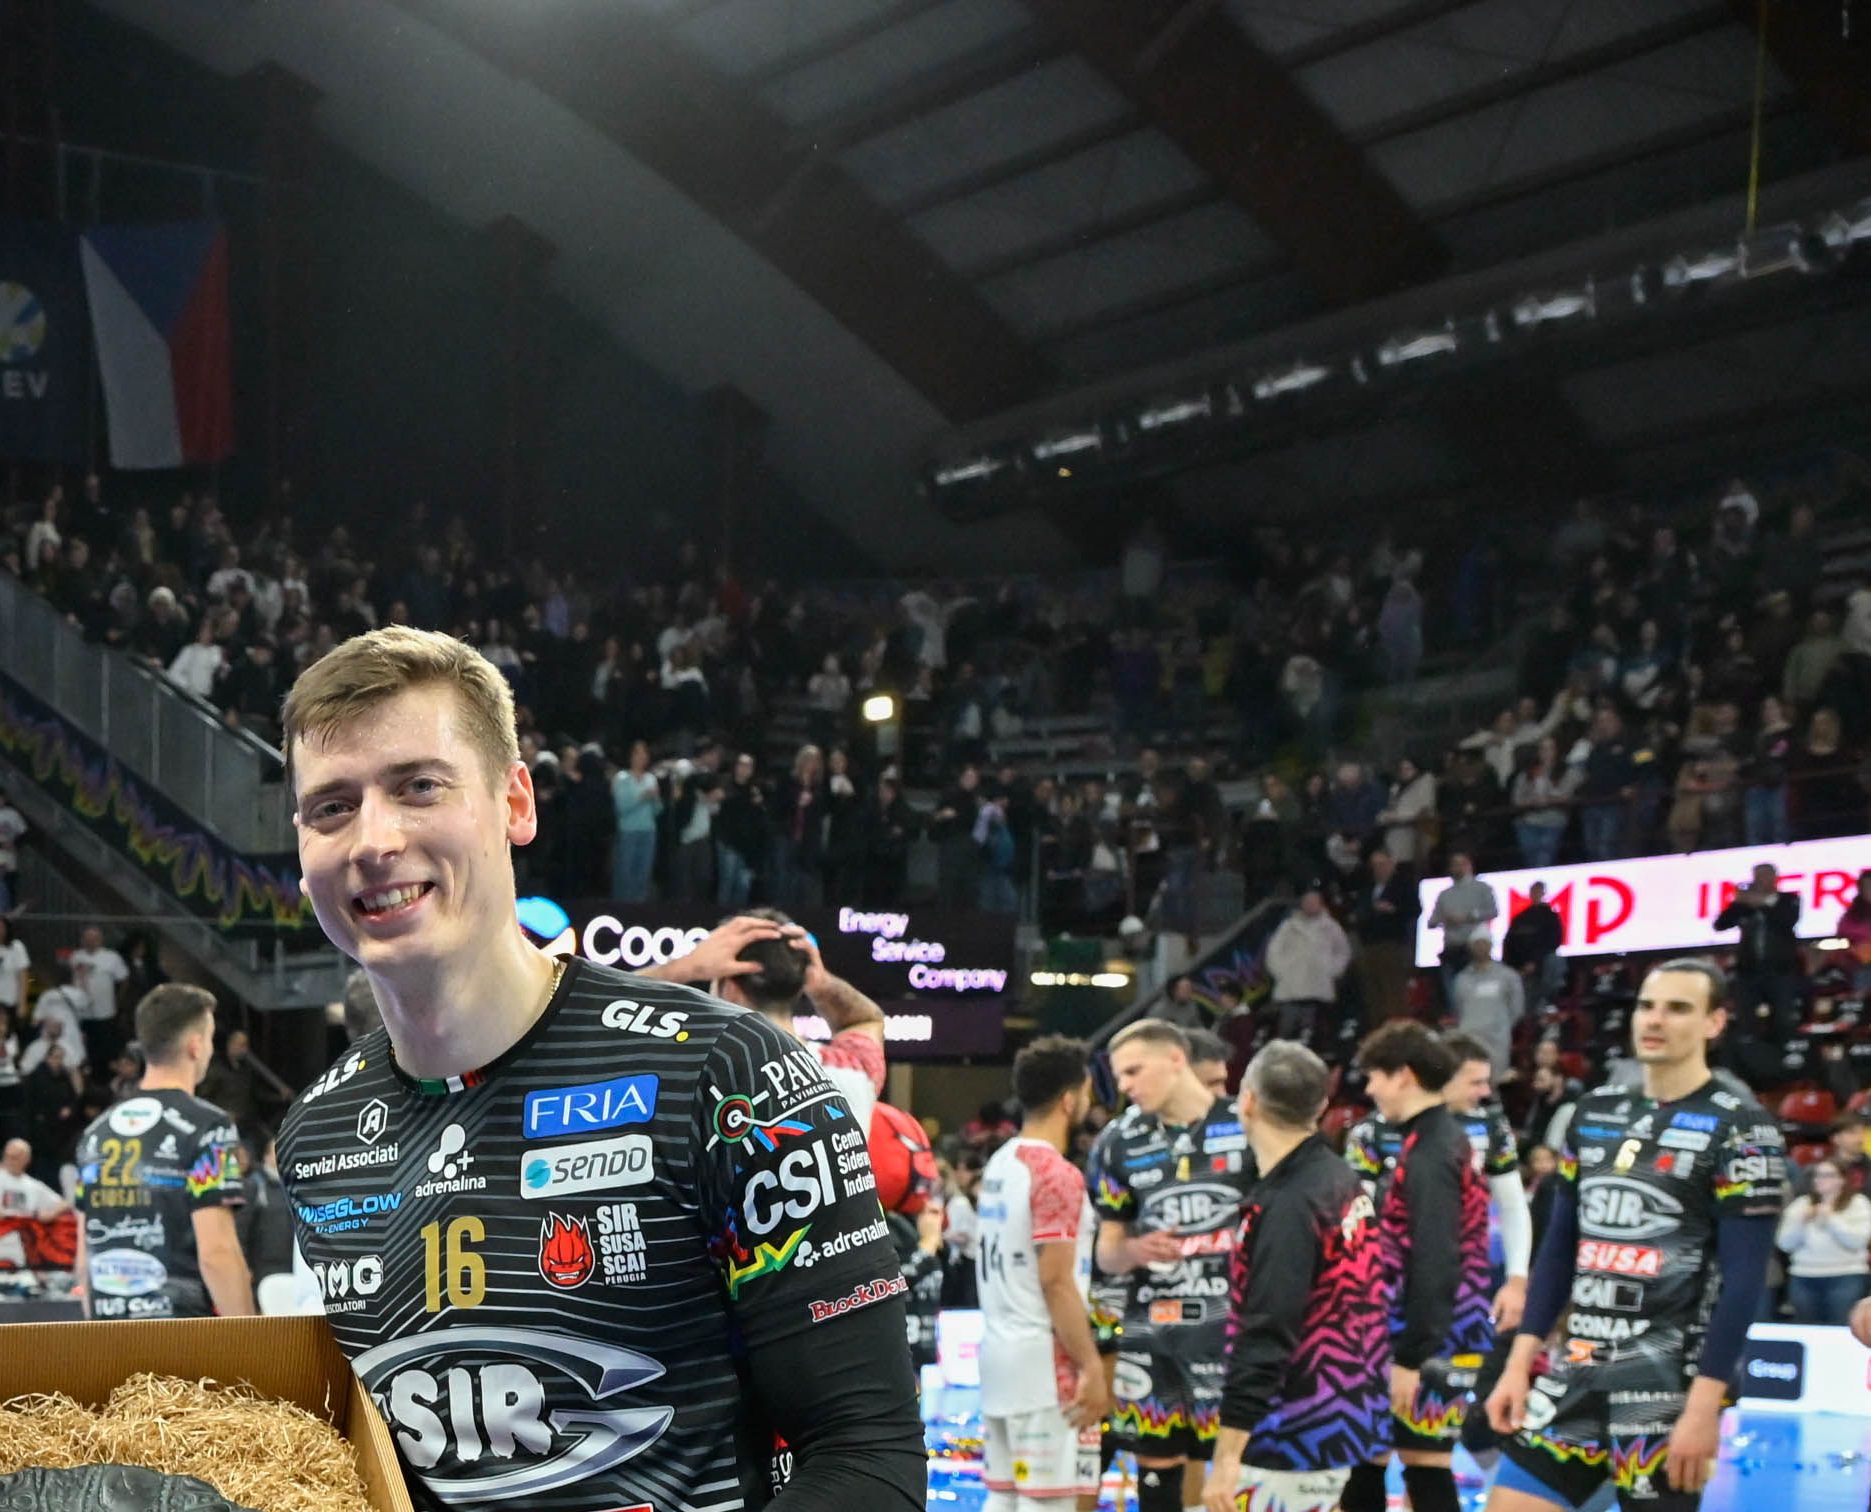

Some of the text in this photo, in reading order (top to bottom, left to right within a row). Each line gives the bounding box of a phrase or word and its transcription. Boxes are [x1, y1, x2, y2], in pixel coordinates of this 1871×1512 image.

[839, 907, 909, 937] Energy
[871, 937, 946, 962] Service
[909, 964, 1007, 992] Company
[531, 1083, 648, 1131] FRIA
[101, 1138, 143, 1187] 22
[295, 1142, 399, 1179] Servizi Associati
[1614, 1139, 1641, 1170] 6
[415, 1175, 486, 1197] adrenalina
[743, 1139, 836, 1235] CSI
[596, 1203, 640, 1235] SIR
[1584, 1188, 1643, 1229] SIR
[599, 1231, 647, 1255] SUSA
[1578, 1240, 1661, 1274] SUSA
[420, 1216, 485, 1313] 16
[602, 1252, 646, 1276] SCAI
[604, 1272, 647, 1285] PERUGIA
[390, 1363, 553, 1469] SIR
